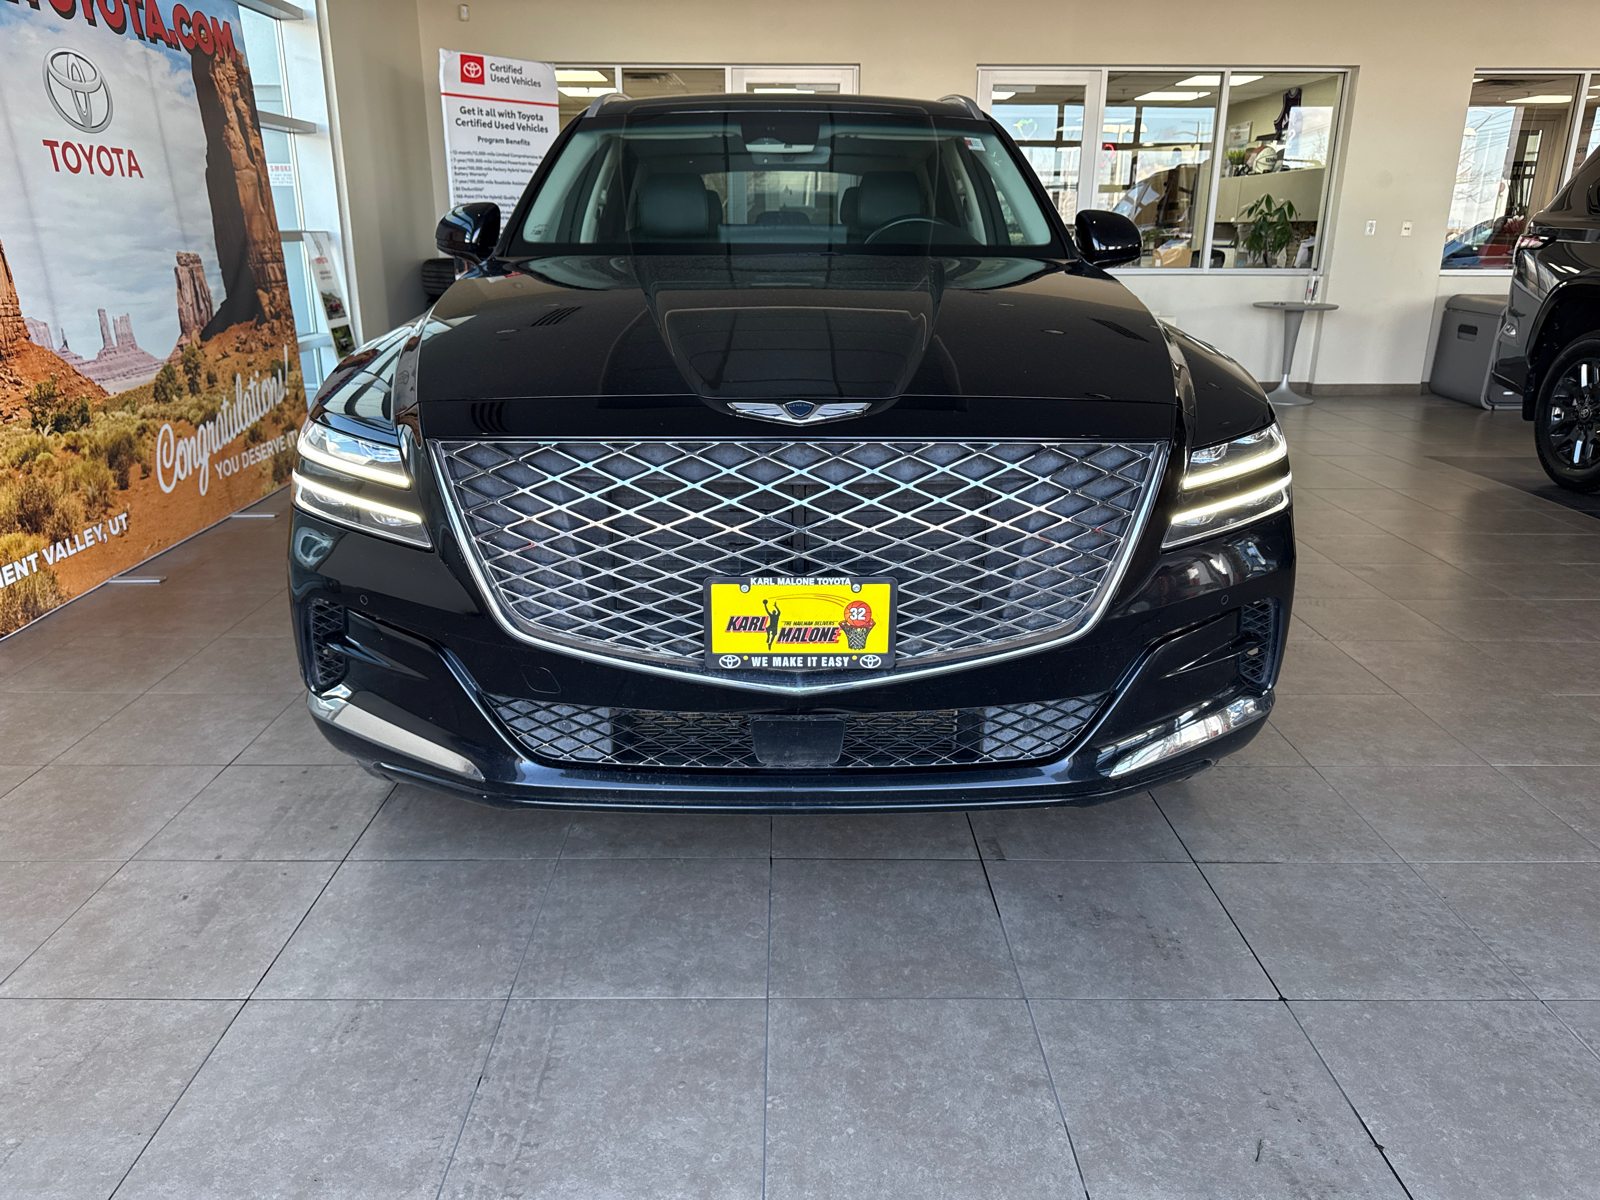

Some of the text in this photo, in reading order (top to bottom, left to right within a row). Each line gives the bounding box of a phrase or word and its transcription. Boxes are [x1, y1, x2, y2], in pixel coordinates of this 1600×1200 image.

[489, 63, 523, 75] Certified
[490, 74, 542, 88] Used Vehicles
[459, 106, 544, 122] Get it all with Toyota
[455, 118, 549, 134] Certified Used Vehicles
[477, 136, 531, 146] Program Benefits
[42, 139, 144, 179] TOYOTA
[156, 344, 290, 497] Congratulations!
[214, 455, 240, 480] YOU
[241, 435, 286, 469] DESERVE
[41, 523, 108, 566] VALLEY,
[108, 513, 129, 536] UT
[750, 577, 851, 586] KARL MALONE TOYOTA
[849, 607, 867, 621] 32
[725, 615, 769, 633] KARL
[776, 626, 841, 644] MALONE
[751, 656, 850, 667] WE MAKE IT EASY
